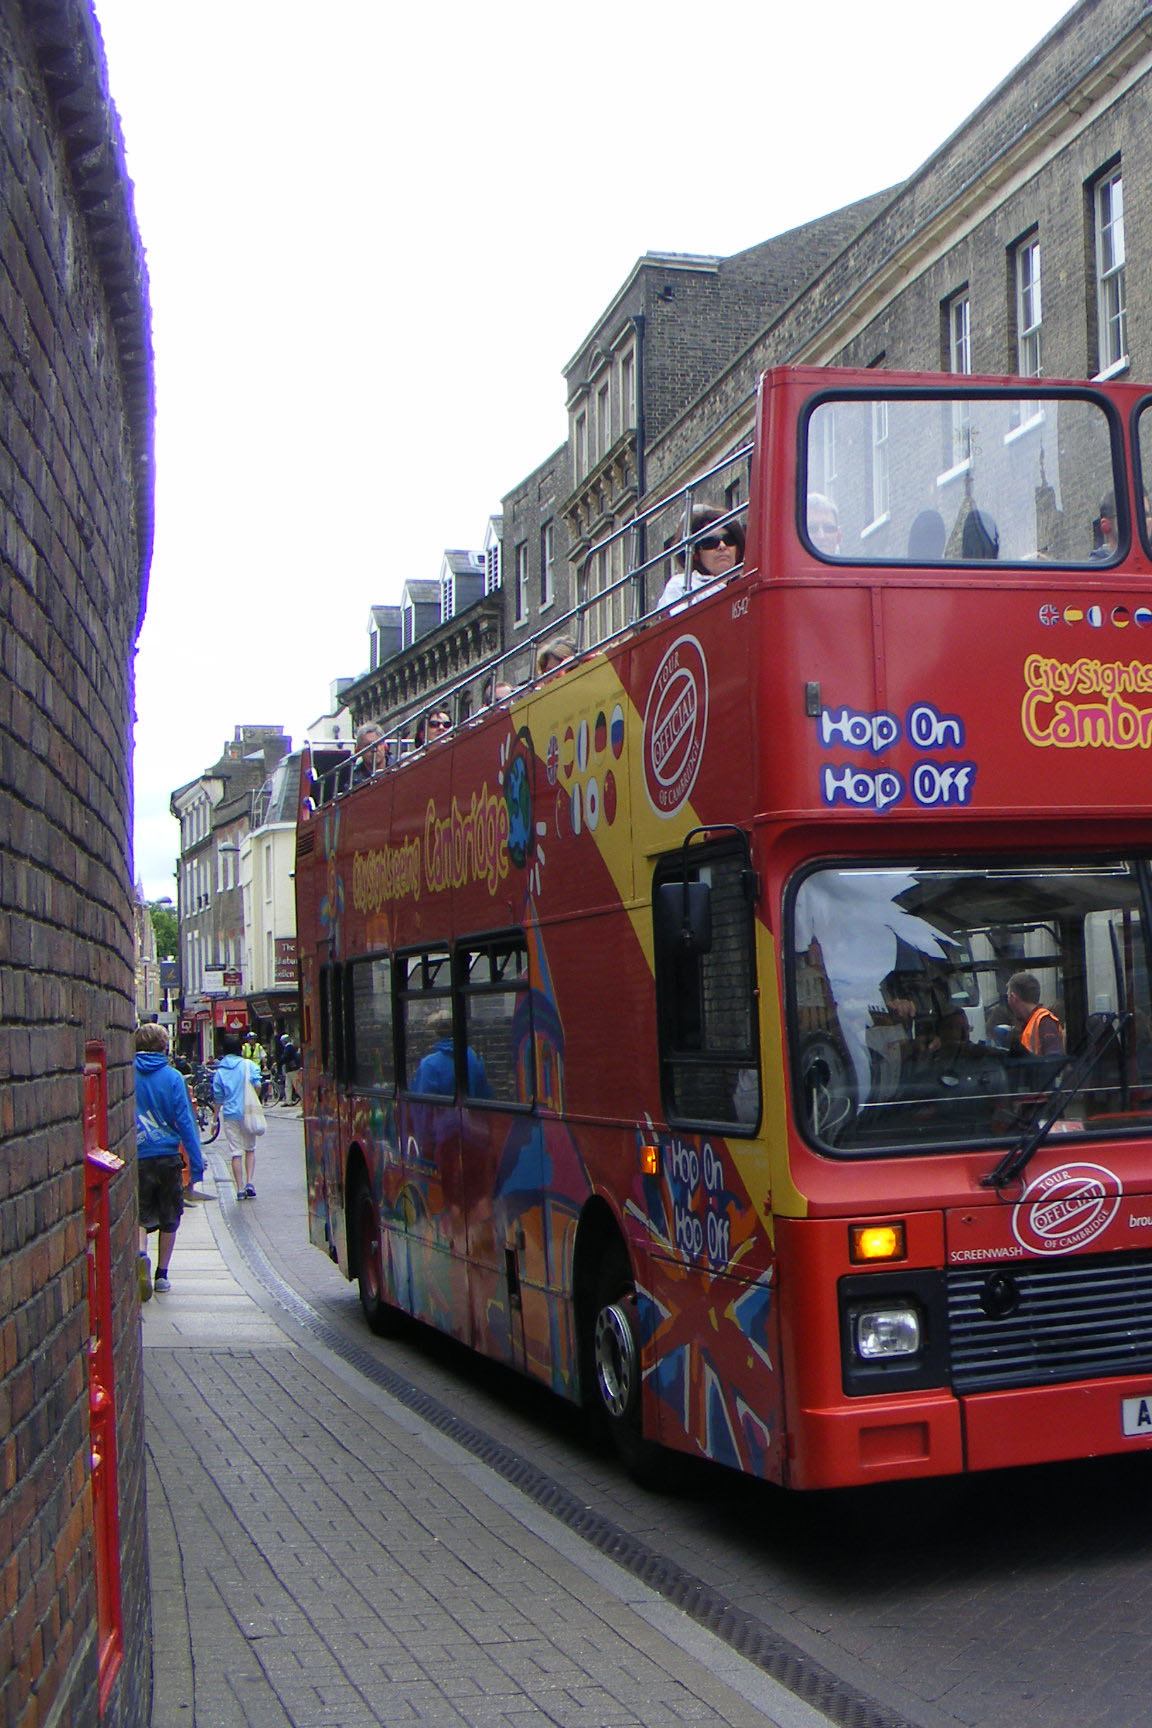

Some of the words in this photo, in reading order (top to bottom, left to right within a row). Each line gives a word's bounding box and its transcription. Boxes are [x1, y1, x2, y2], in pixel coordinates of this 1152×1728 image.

[658, 651, 680, 692] TOUR
[653, 692, 695, 766] OFFICIAL
[822, 709, 898, 751] Hop
[910, 706, 961, 747] On
[667, 737, 700, 805] CAMBRIDGE
[825, 767, 901, 809] Hop
[914, 764, 972, 804] Off
[425, 781, 510, 896] Cambridge
[671, 1139, 699, 1191] Hop
[703, 1142, 724, 1191] On
[1038, 1170, 1071, 1191] TOUR
[1035, 1187, 1099, 1229] OFFICIAL
[1044, 1239, 1057, 1248] OF
[1059, 1209, 1110, 1248] CAMBRIDGE
[675, 1204, 703, 1254] Hop
[707, 1211, 729, 1262] Off
[950, 1246, 1023, 1262] SCREENWASH
